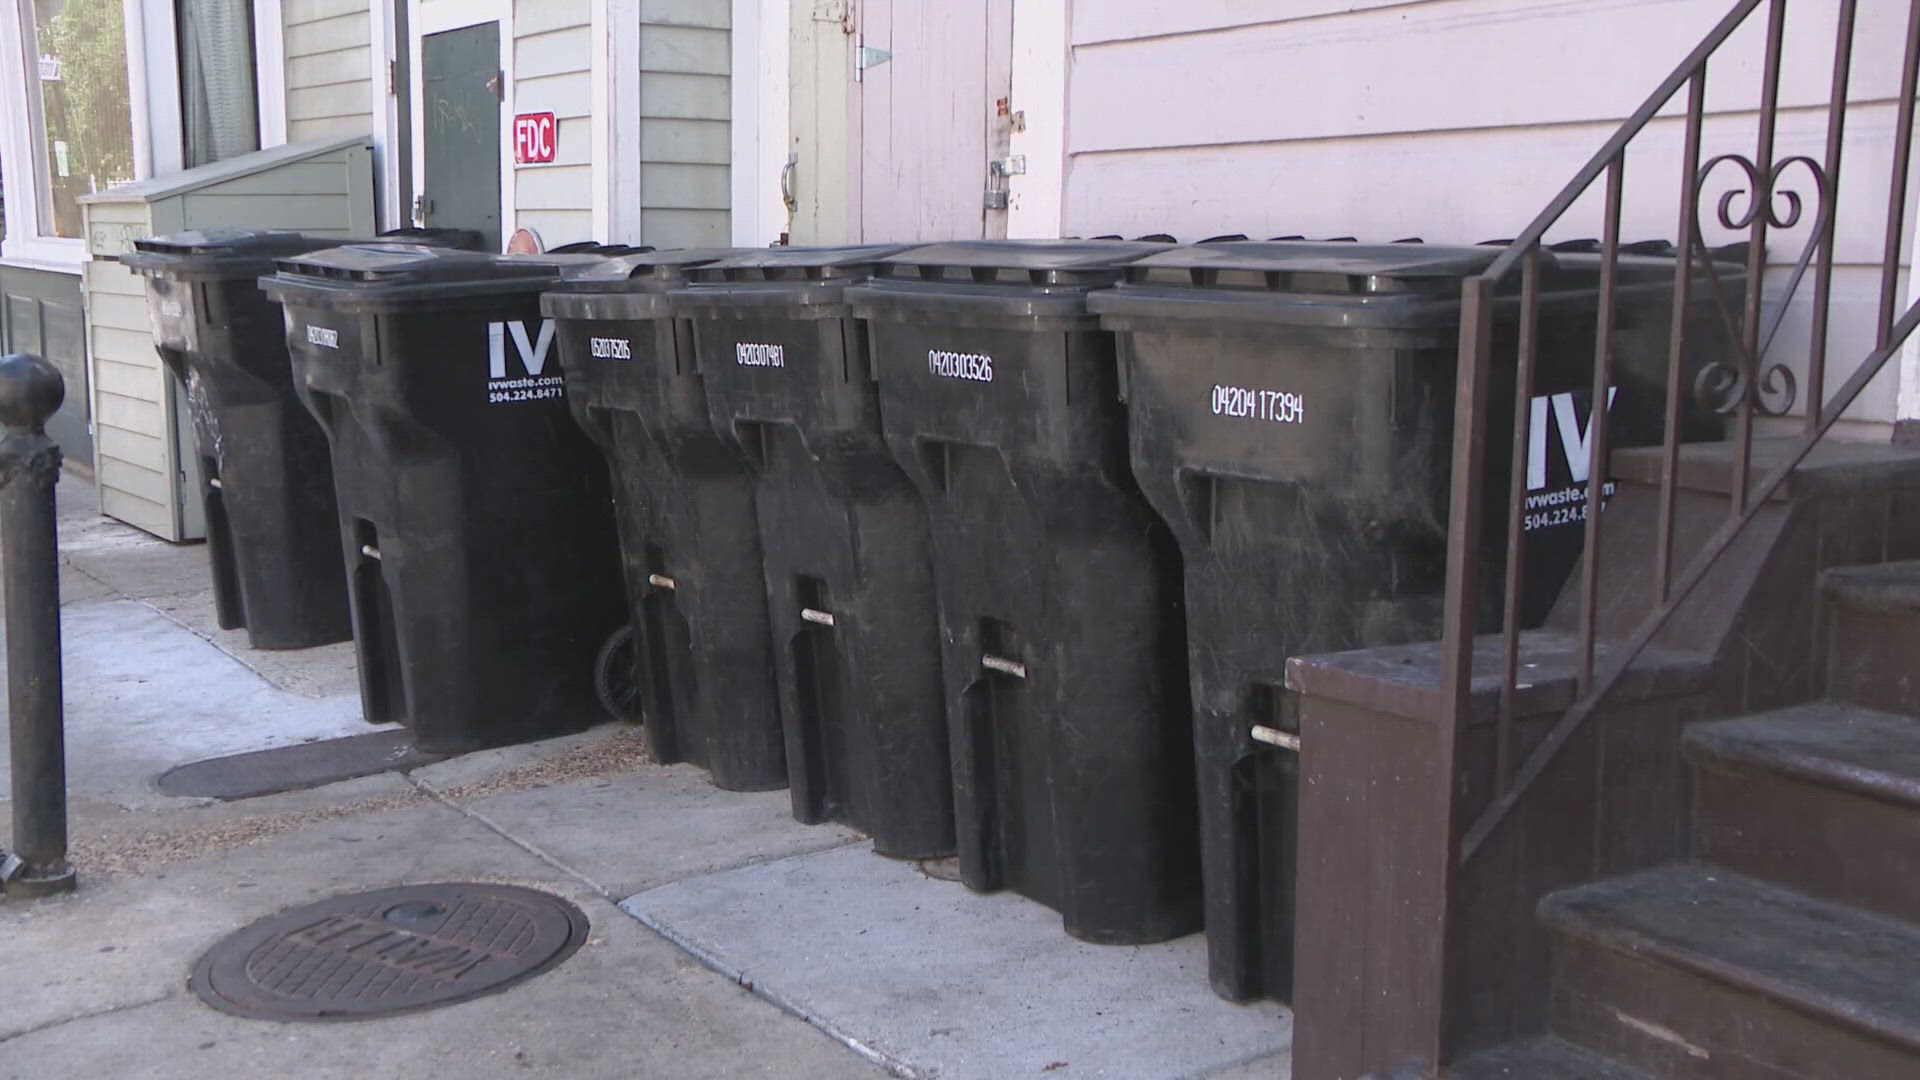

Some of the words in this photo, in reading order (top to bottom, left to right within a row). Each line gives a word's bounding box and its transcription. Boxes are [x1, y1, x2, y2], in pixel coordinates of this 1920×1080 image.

[516, 118, 550, 158] FDC
[488, 319, 556, 378] IV
[736, 343, 784, 367] 0420307481
[928, 349, 993, 382] 0420303526
[489, 377, 562, 390] ivwaste.com
[489, 388, 562, 402] 504.224.8471
[1527, 386, 1617, 490] IV
[1525, 482, 1614, 510] ivwaste.cm
